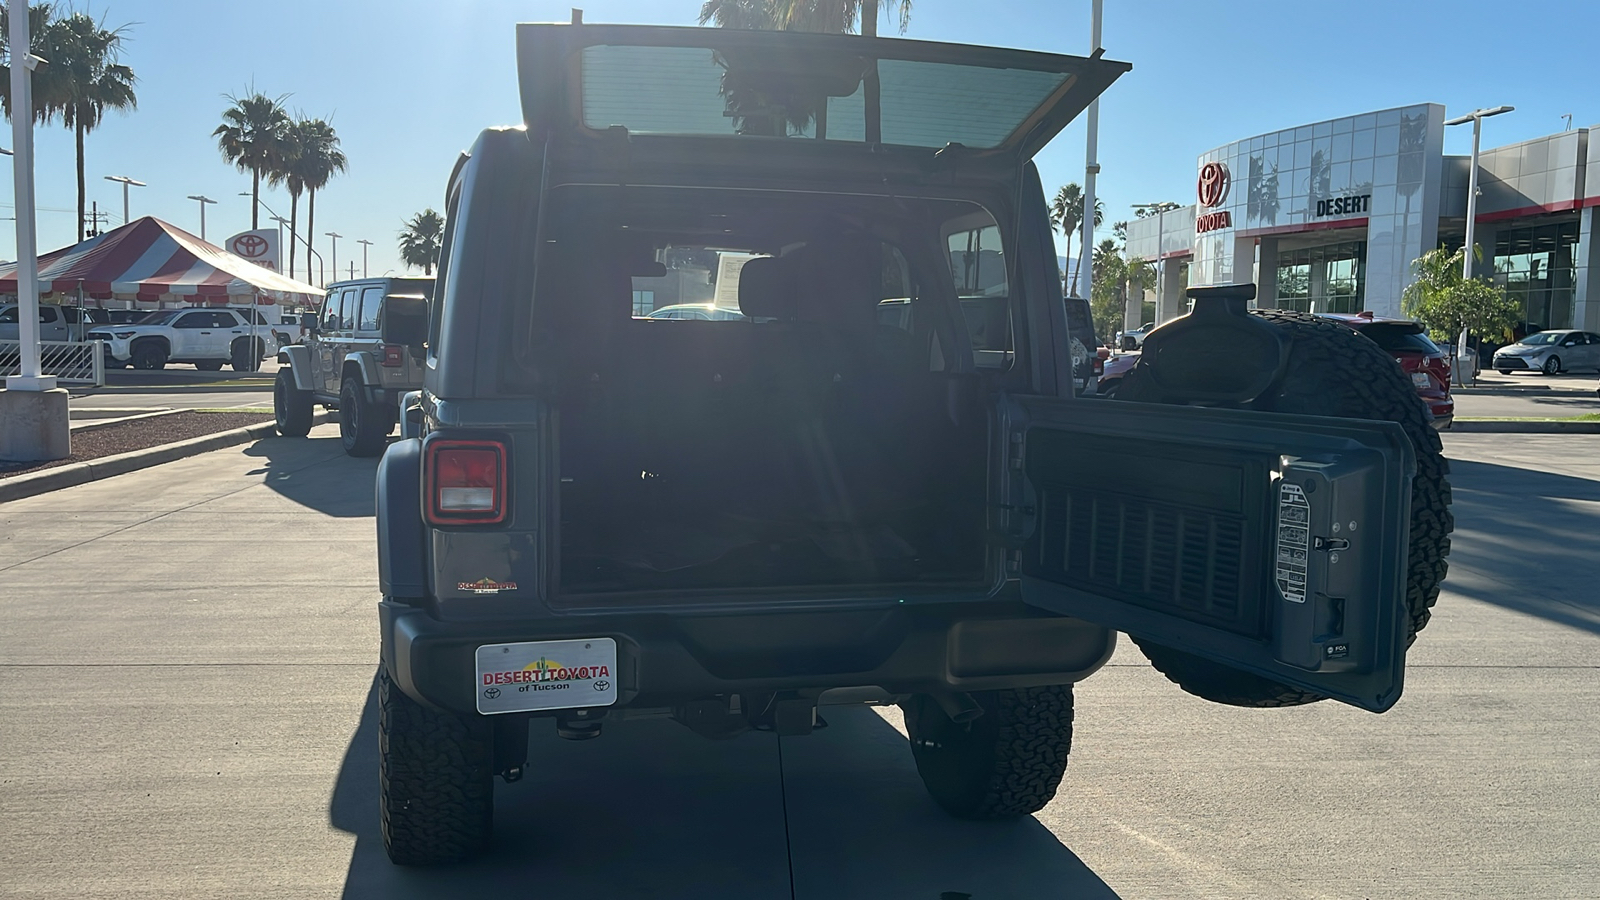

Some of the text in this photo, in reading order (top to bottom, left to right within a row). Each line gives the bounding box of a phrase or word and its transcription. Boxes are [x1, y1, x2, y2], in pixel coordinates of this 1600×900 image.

[1316, 194, 1371, 217] DESERT
[1196, 211, 1229, 233] TOYOTA
[483, 666, 610, 686] DESERT TOYOTA
[518, 683, 570, 693] of Tucson
